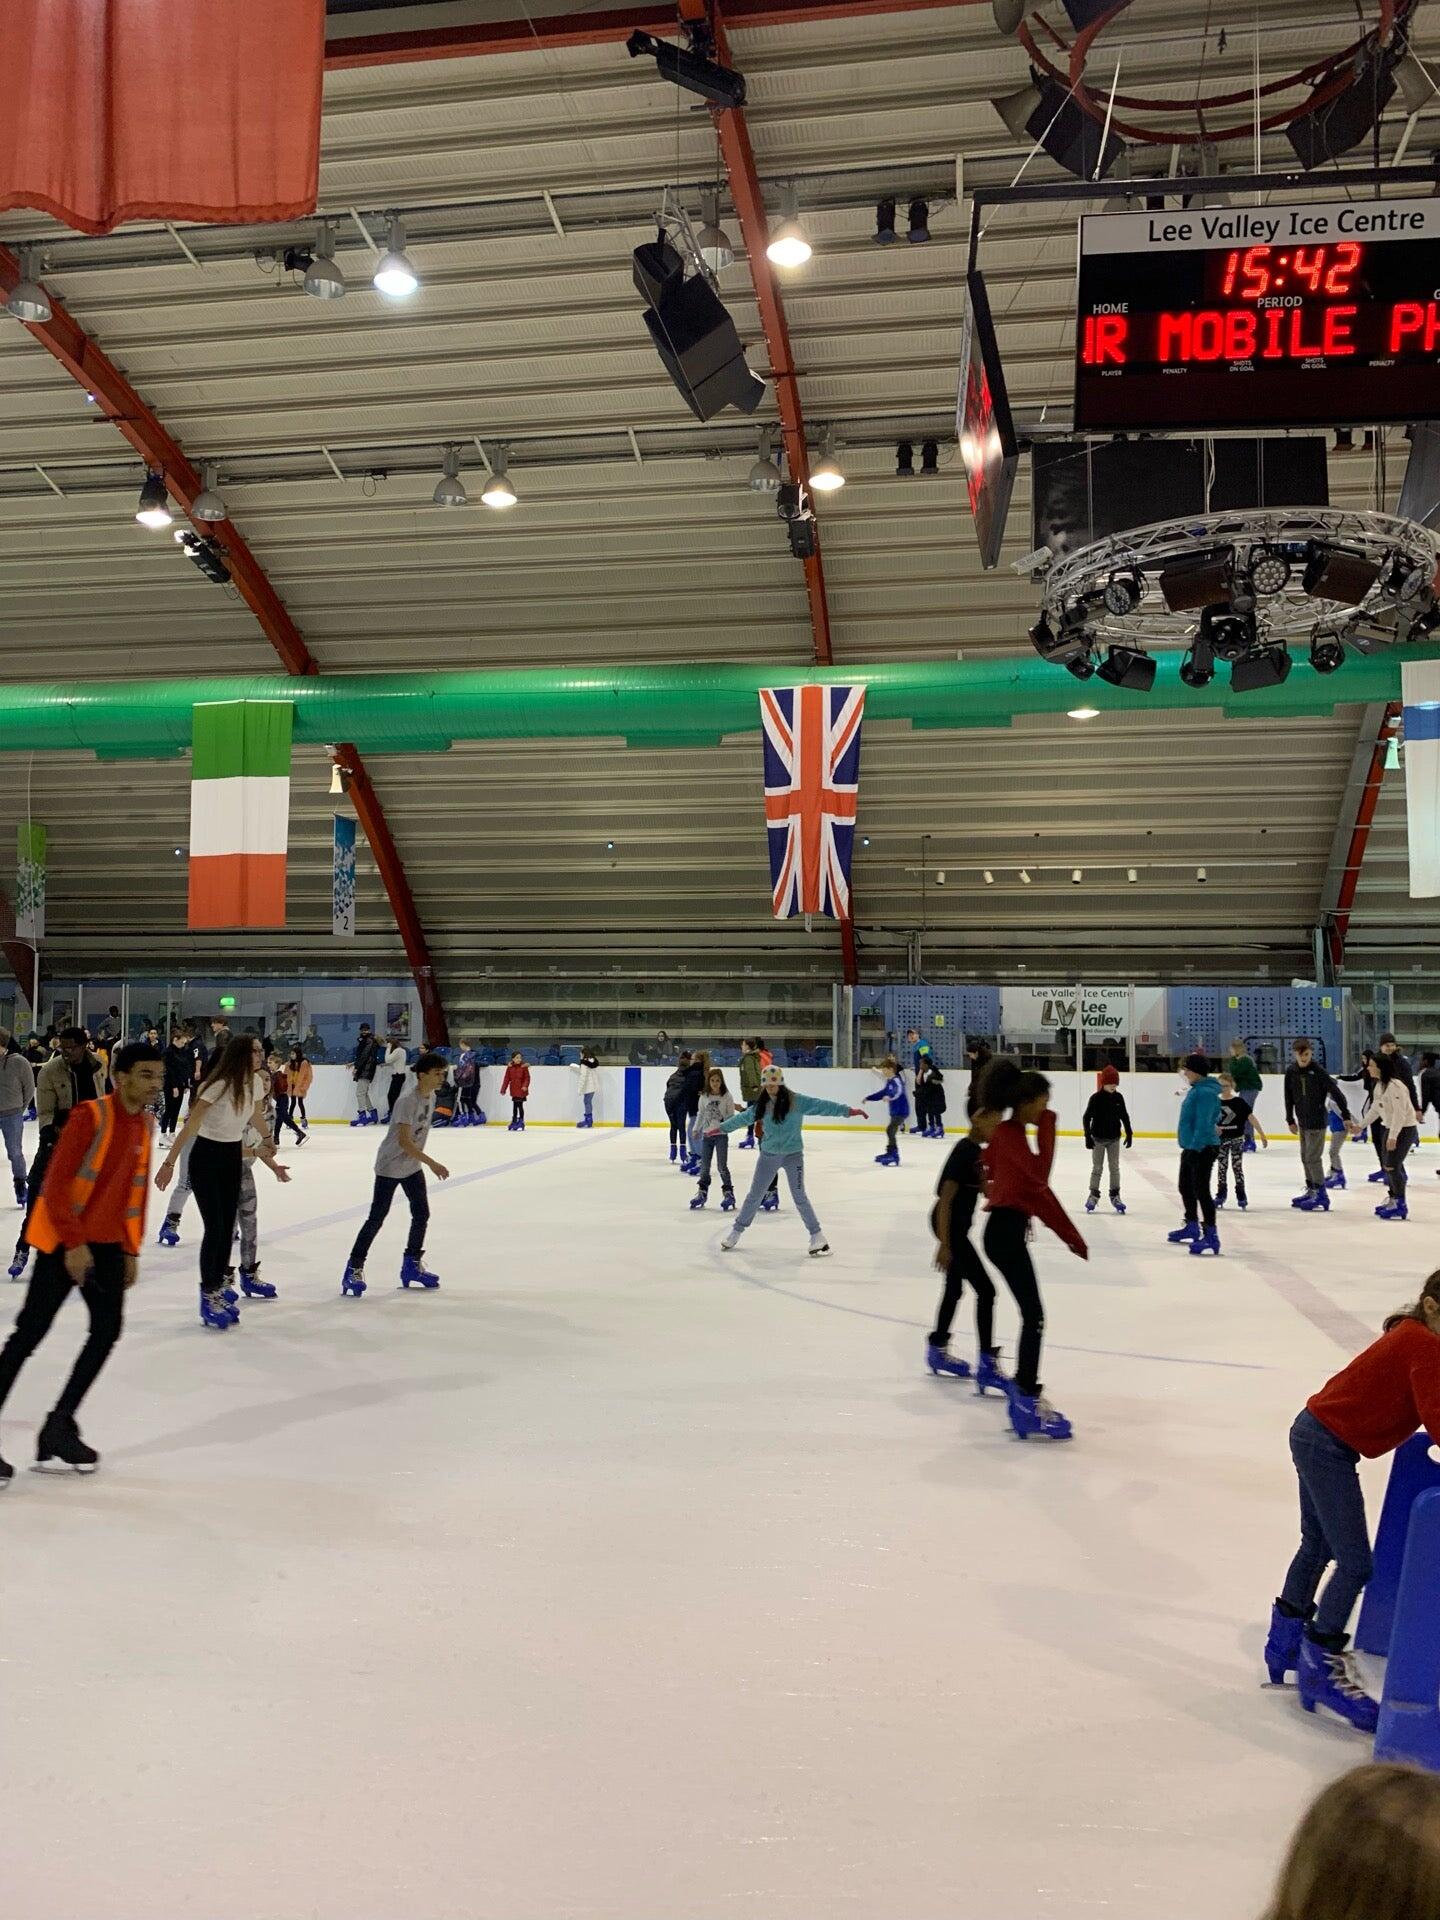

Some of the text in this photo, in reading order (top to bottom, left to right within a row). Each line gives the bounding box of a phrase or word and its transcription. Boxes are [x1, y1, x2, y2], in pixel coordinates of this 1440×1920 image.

[1149, 209, 1425, 244] Lee Valley Ice Centre
[1223, 243, 1361, 298] 15:42
[1092, 302, 1129, 315] HOME
[1257, 295, 1303, 309] PERIOD
[1158, 305, 1358, 362] MOBILE
[1369, 359, 1396, 367] PENALTY
[1162, 367, 1188, 375] PENALTY
[343, 915, 349, 930] 2
[1031, 989, 1049, 998] Lee
[1050, 989, 1079, 998] Valle
[1083, 989, 1098, 998] Ice
[1081, 1000, 1107, 1013] Lee
[1081, 1014, 1123, 1029] Valley
